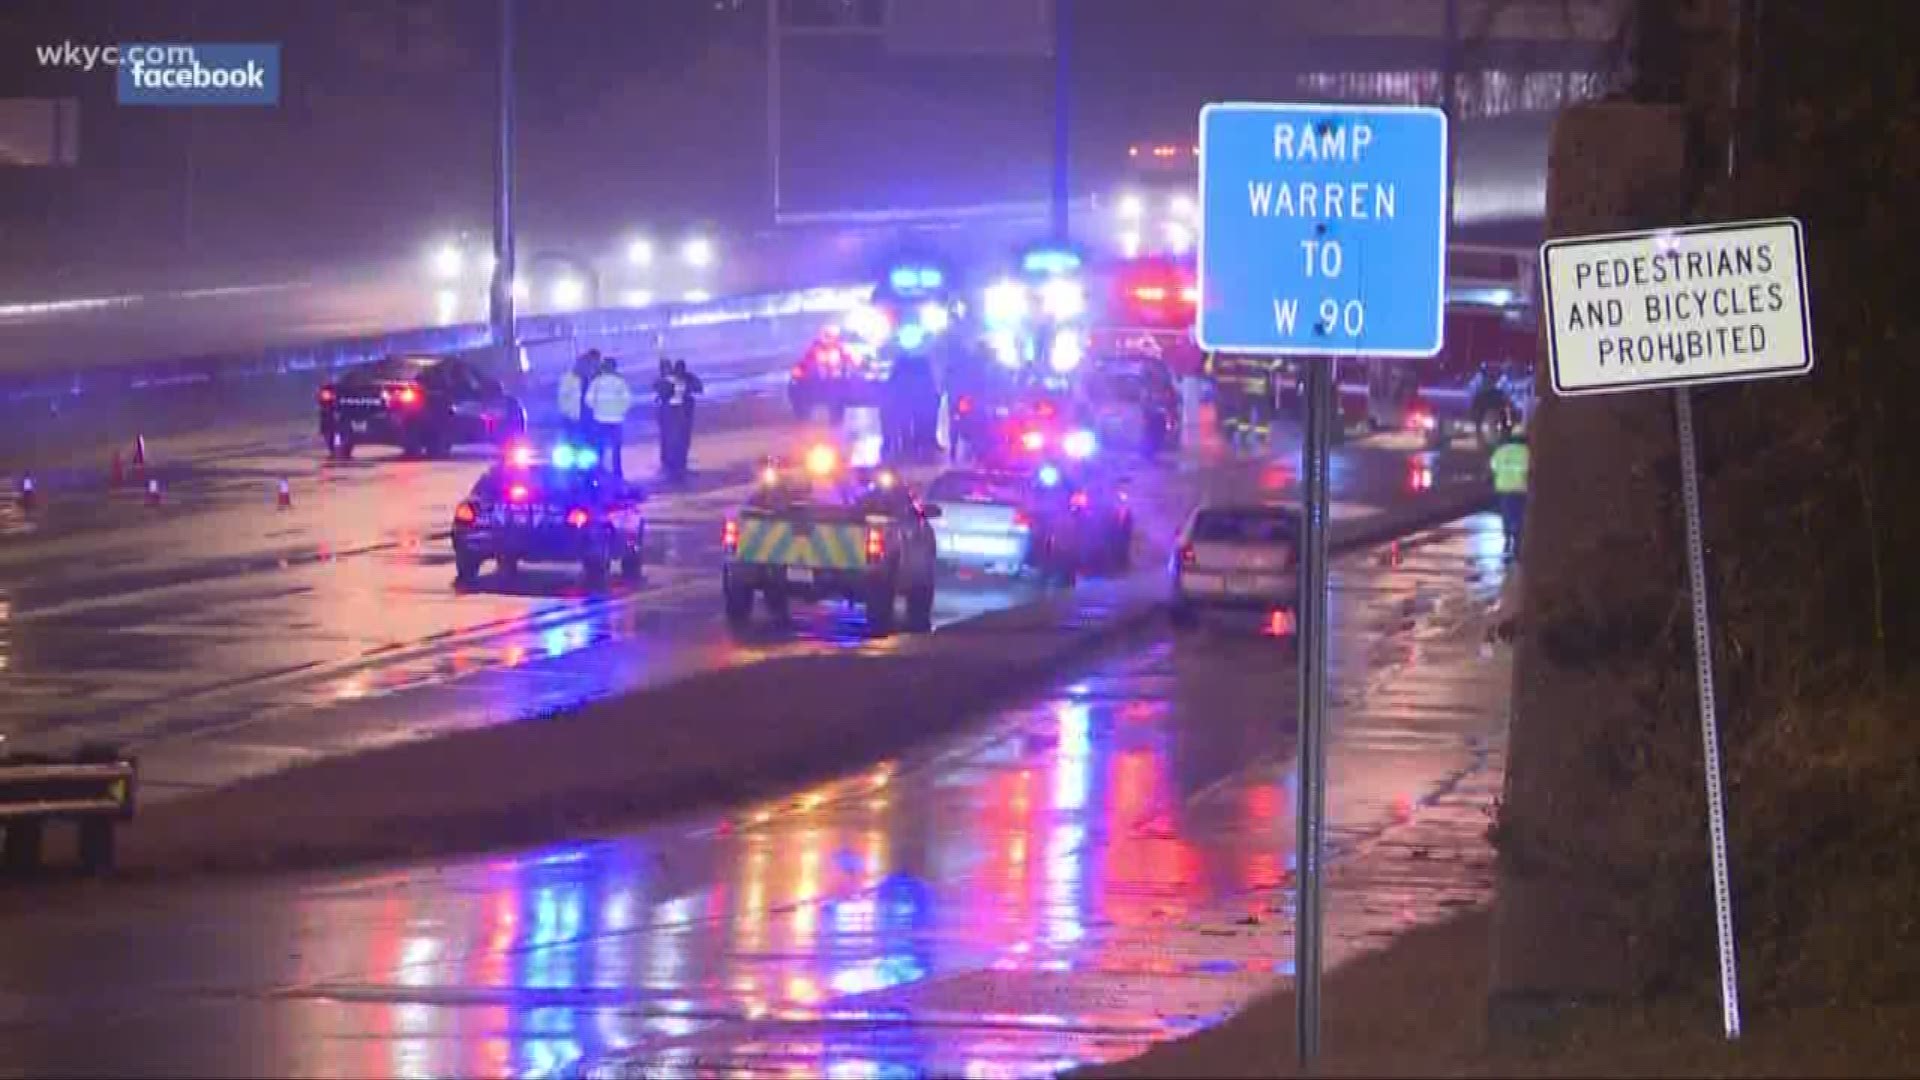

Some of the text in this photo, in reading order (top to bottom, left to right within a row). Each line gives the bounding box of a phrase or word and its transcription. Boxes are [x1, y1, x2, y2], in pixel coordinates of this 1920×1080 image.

[1273, 122, 1373, 162] RAMP
[1247, 181, 1395, 219] WARREN
[1301, 240, 1342, 278] TO
[1576, 245, 1773, 290] PEDESTRIANS
[1273, 299, 1364, 337] W 90
[1568, 283, 1784, 332] AND BICYCLES
[1599, 324, 1767, 366] PROHIBITED
